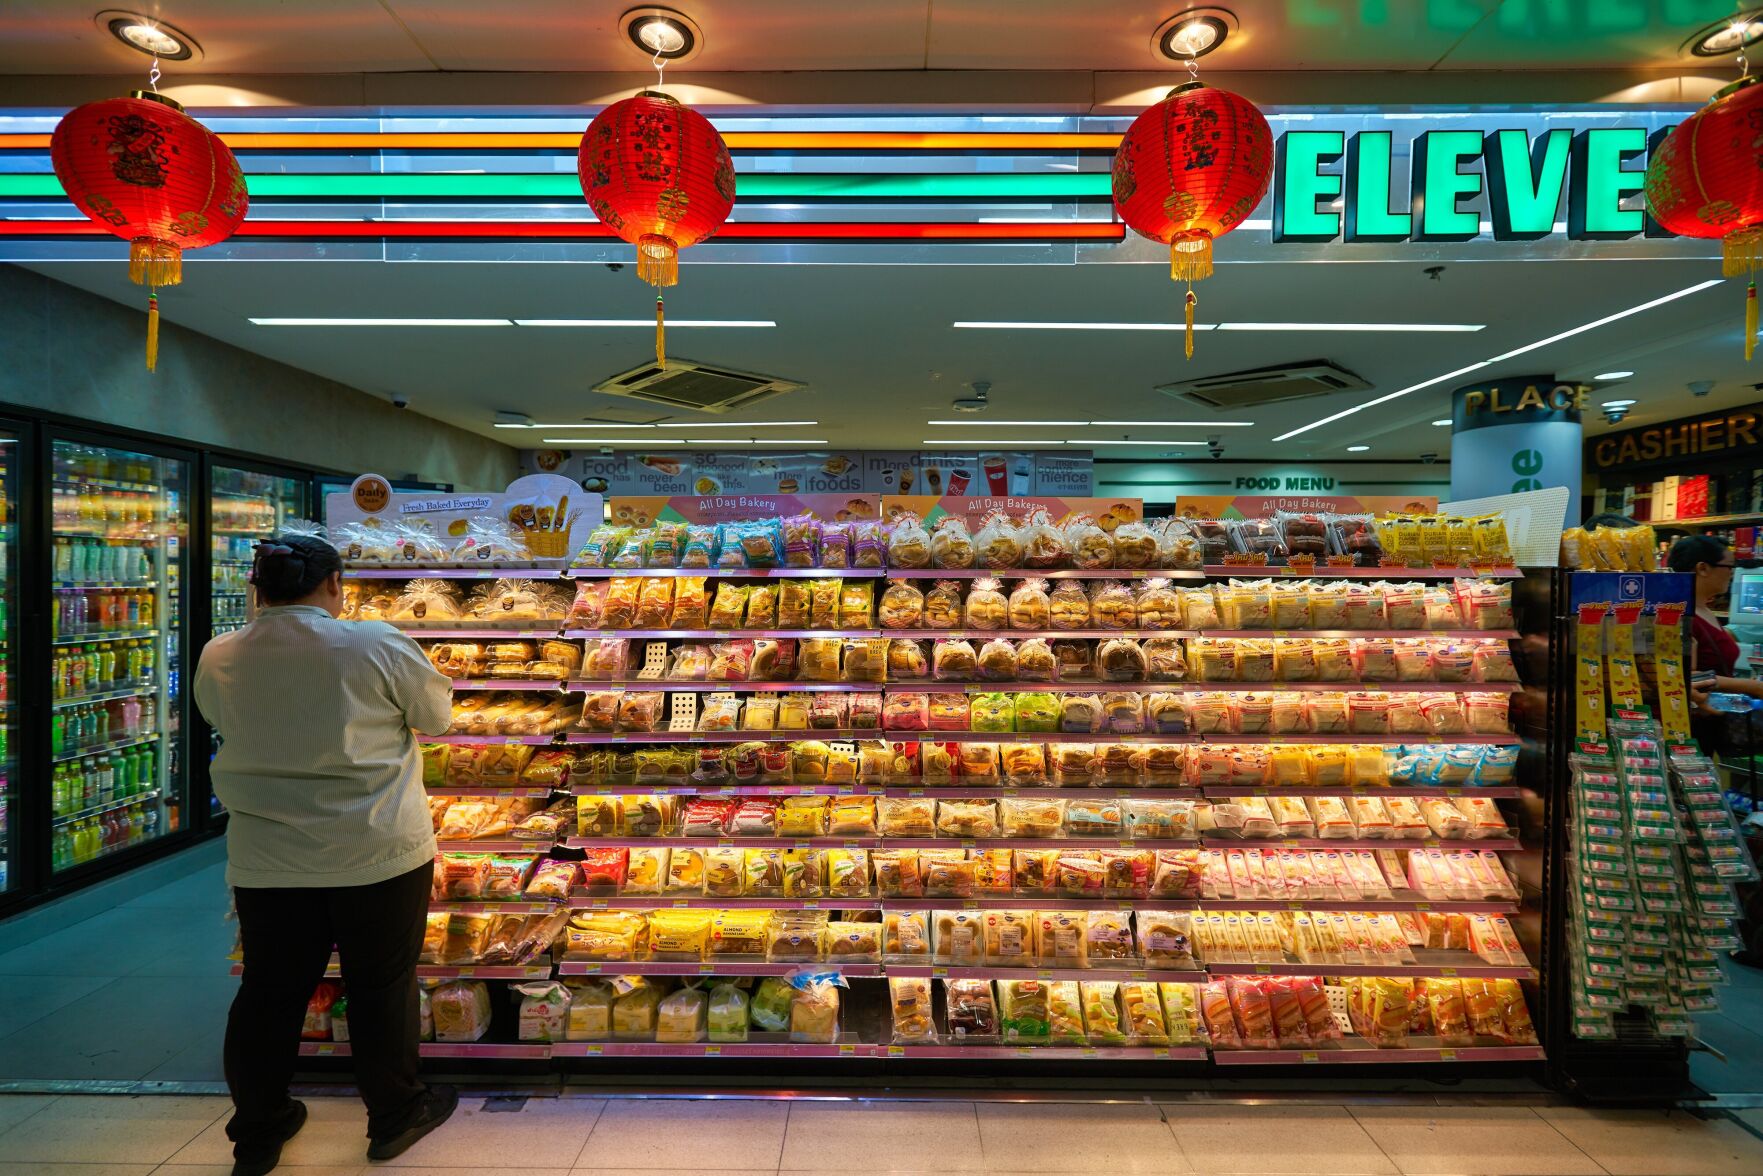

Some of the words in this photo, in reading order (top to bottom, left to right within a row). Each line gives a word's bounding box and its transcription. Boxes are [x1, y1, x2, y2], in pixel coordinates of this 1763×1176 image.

[1274, 128, 1678, 242] ELEVE
[1465, 385, 1593, 416] PLACE
[1595, 414, 1758, 468] CASHIER
[583, 459, 628, 474] Food
[869, 458, 910, 470] more
[613, 474, 631, 482] has
[639, 474, 674, 482] never
[809, 475, 861, 491] foods
[1041, 473, 1088, 483] nience
[1236, 477, 1281, 490] FOOD
[1285, 477, 1334, 490] MENU
[358, 488, 386, 498] Daily
[654, 482, 687, 493] been
[402, 503, 424, 512] Fresh
[426, 501, 451, 510] Baked
[453, 498, 490, 509] Everyday
[700, 499, 714, 510] All
[716, 497, 736, 509] Day
[739, 497, 776, 511] Bakery
[968, 500, 982, 511] All
[984, 498, 1004, 509] Day
[1262, 500, 1276, 511] All
[1279, 498, 1298, 509] Day
[1302, 498, 1337, 512] Bakery
